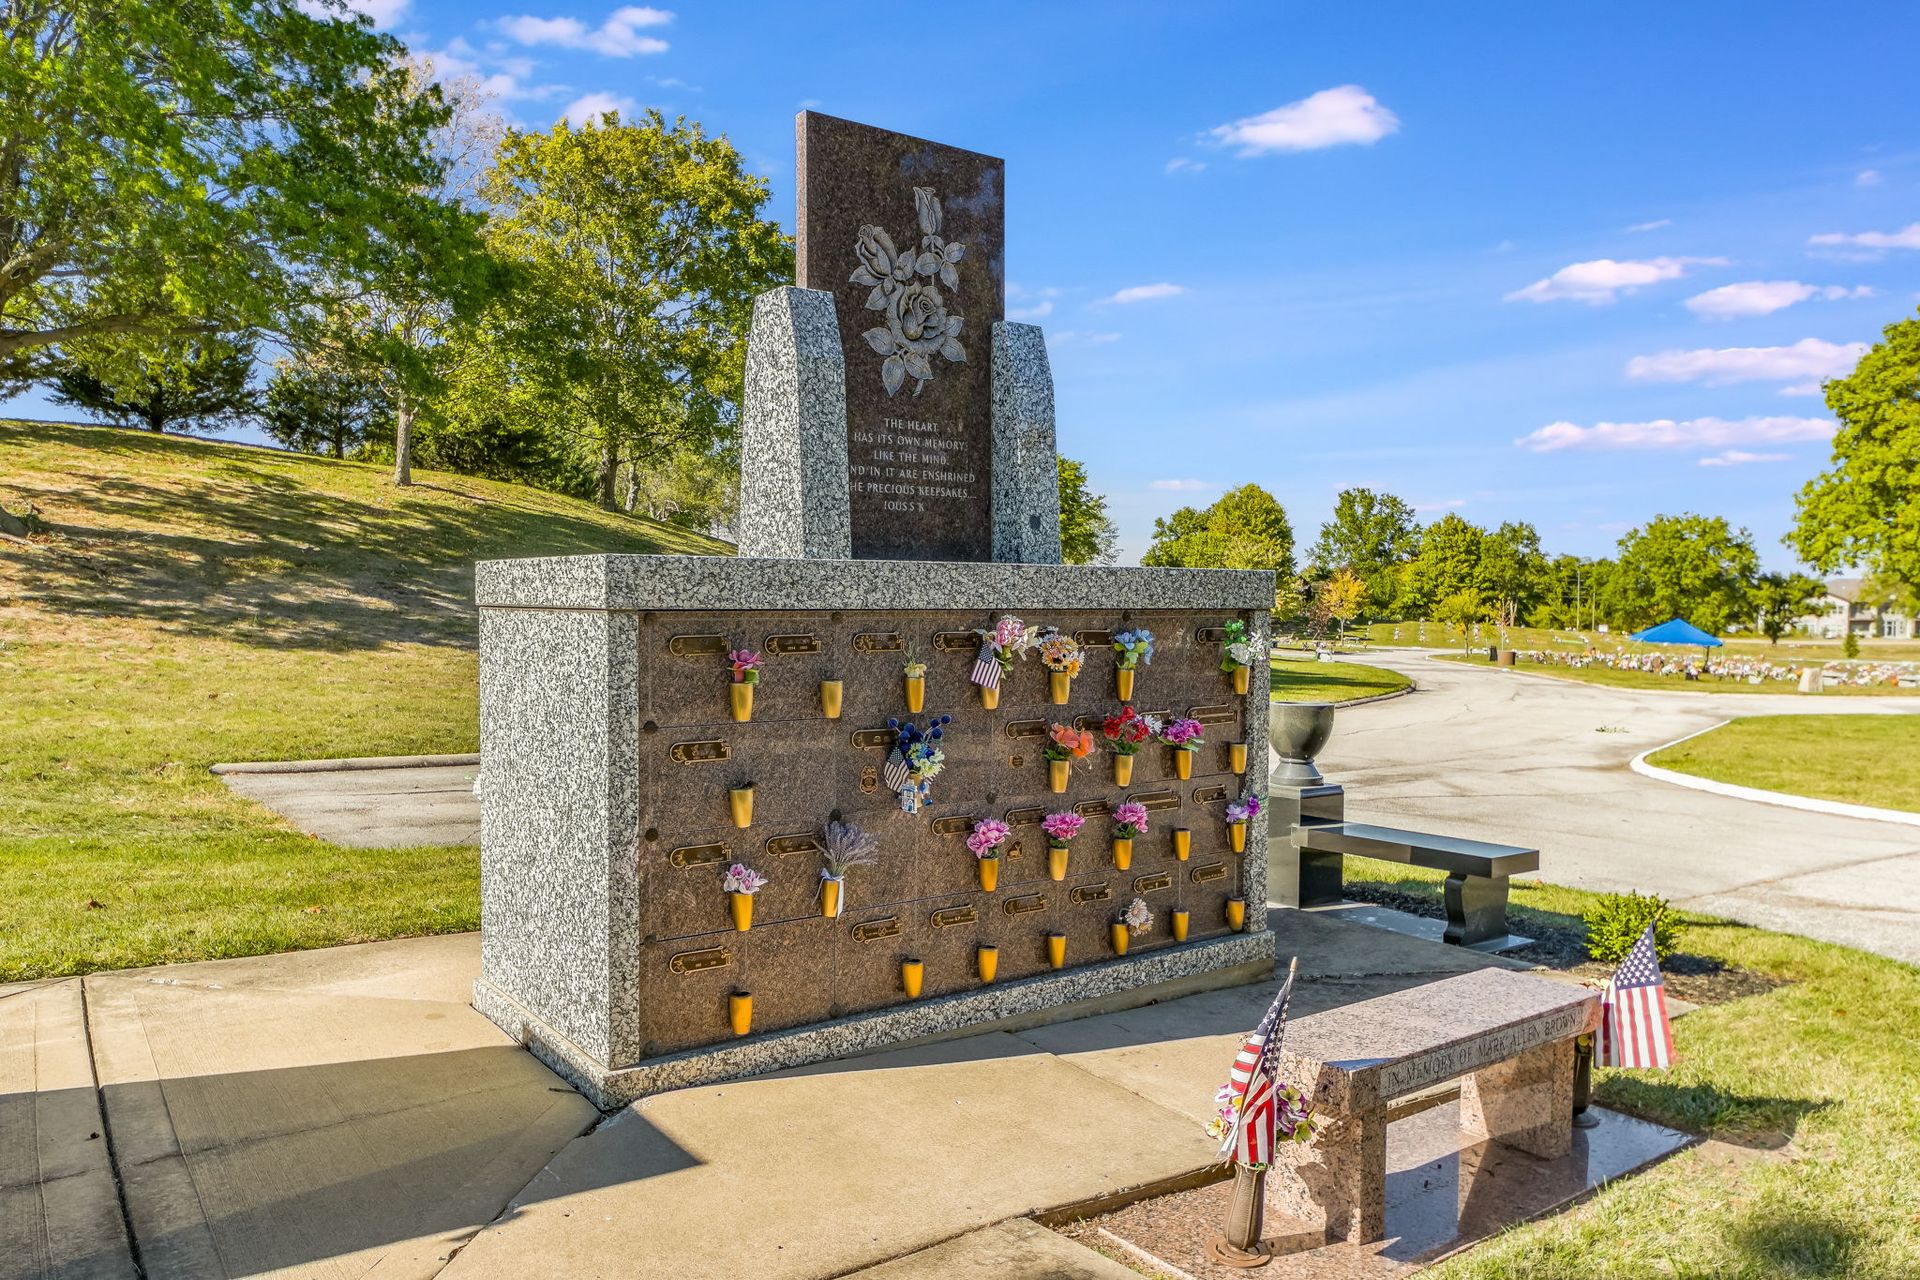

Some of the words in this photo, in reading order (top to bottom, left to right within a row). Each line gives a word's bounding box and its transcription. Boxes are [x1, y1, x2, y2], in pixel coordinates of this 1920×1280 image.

[885, 418, 902, 429] THE
[908, 420, 938, 432] HEART
[854, 432, 873, 443] HAS
[877, 434, 893, 445] ITS
[897, 435, 921, 447] OWN
[874, 450, 894, 460] LIKE
[899, 452, 918, 463] THE
[850, 465, 865, 476] ND
[870, 466, 880, 477] IN
[886, 467, 895, 478] IT
[899, 469, 918, 480] ARE
[923, 470, 976, 483] ENSHRINED
[850, 481, 863, 492] HE
[867, 482, 915, 495] PRECIOUS
[1387, 1071, 1400, 1088] IN
[1406, 1055, 1454, 1081] MEMORY
[1459, 1048, 1473, 1065] OF
[1478, 1036, 1506, 1057] MARK
[1511, 1026, 1540, 1047] ALLEN
[1544, 1014, 1577, 1036] BROWN
